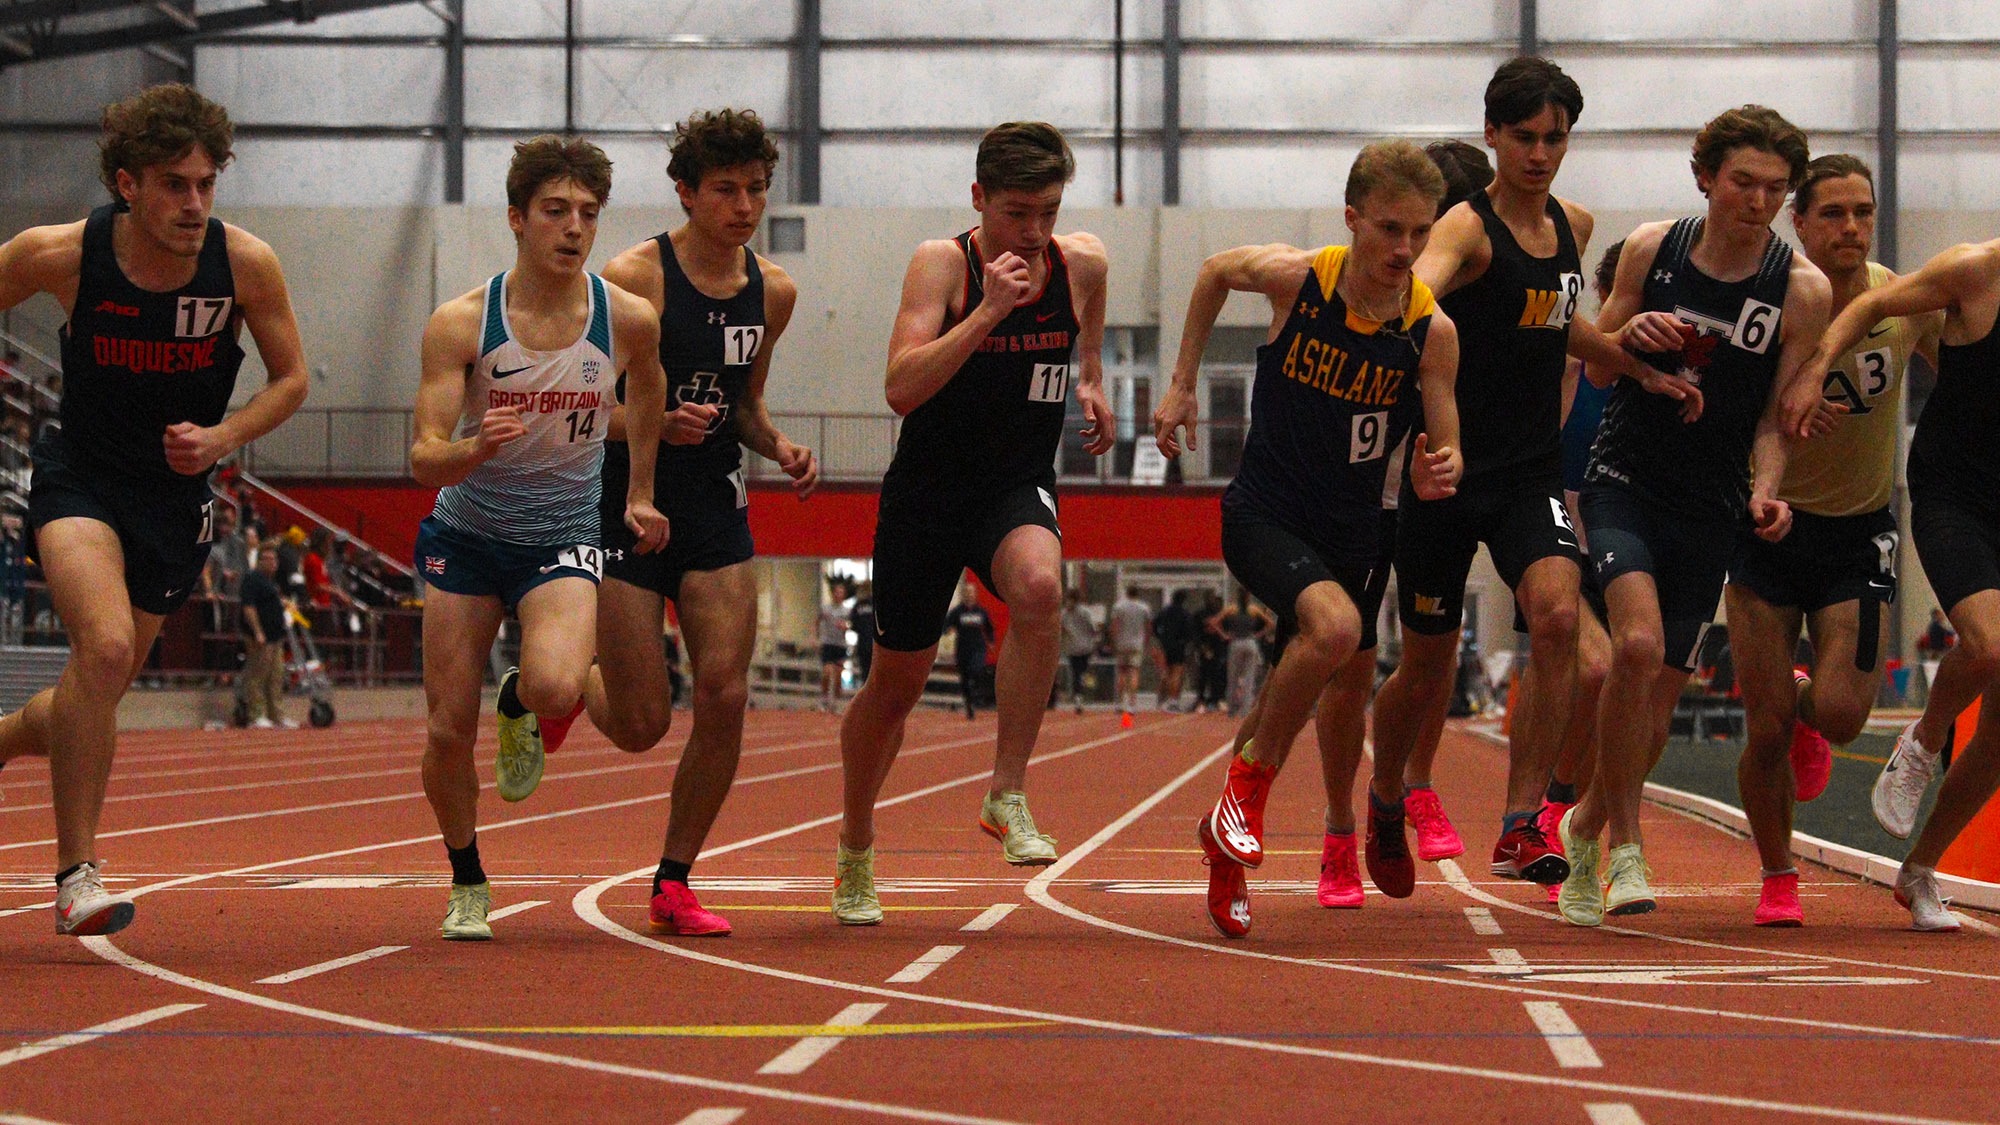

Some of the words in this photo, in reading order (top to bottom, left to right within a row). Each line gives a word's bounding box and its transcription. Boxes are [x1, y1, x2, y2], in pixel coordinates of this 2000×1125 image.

[181, 298, 226, 335] 17
[1564, 276, 1579, 321] 8
[1022, 331, 1070, 351] ELKINS
[1741, 305, 1772, 349] 6
[93, 334, 219, 374] DUQUESNE
[732, 328, 758, 364] 12
[1040, 366, 1065, 400] 11
[1864, 352, 1887, 395] 3
[488, 389, 539, 413] GREAT
[539, 391, 601, 414] BRITAIN
[565, 409, 596, 443] 14
[1358, 415, 1379, 460] 9
[566, 546, 599, 575] 14
